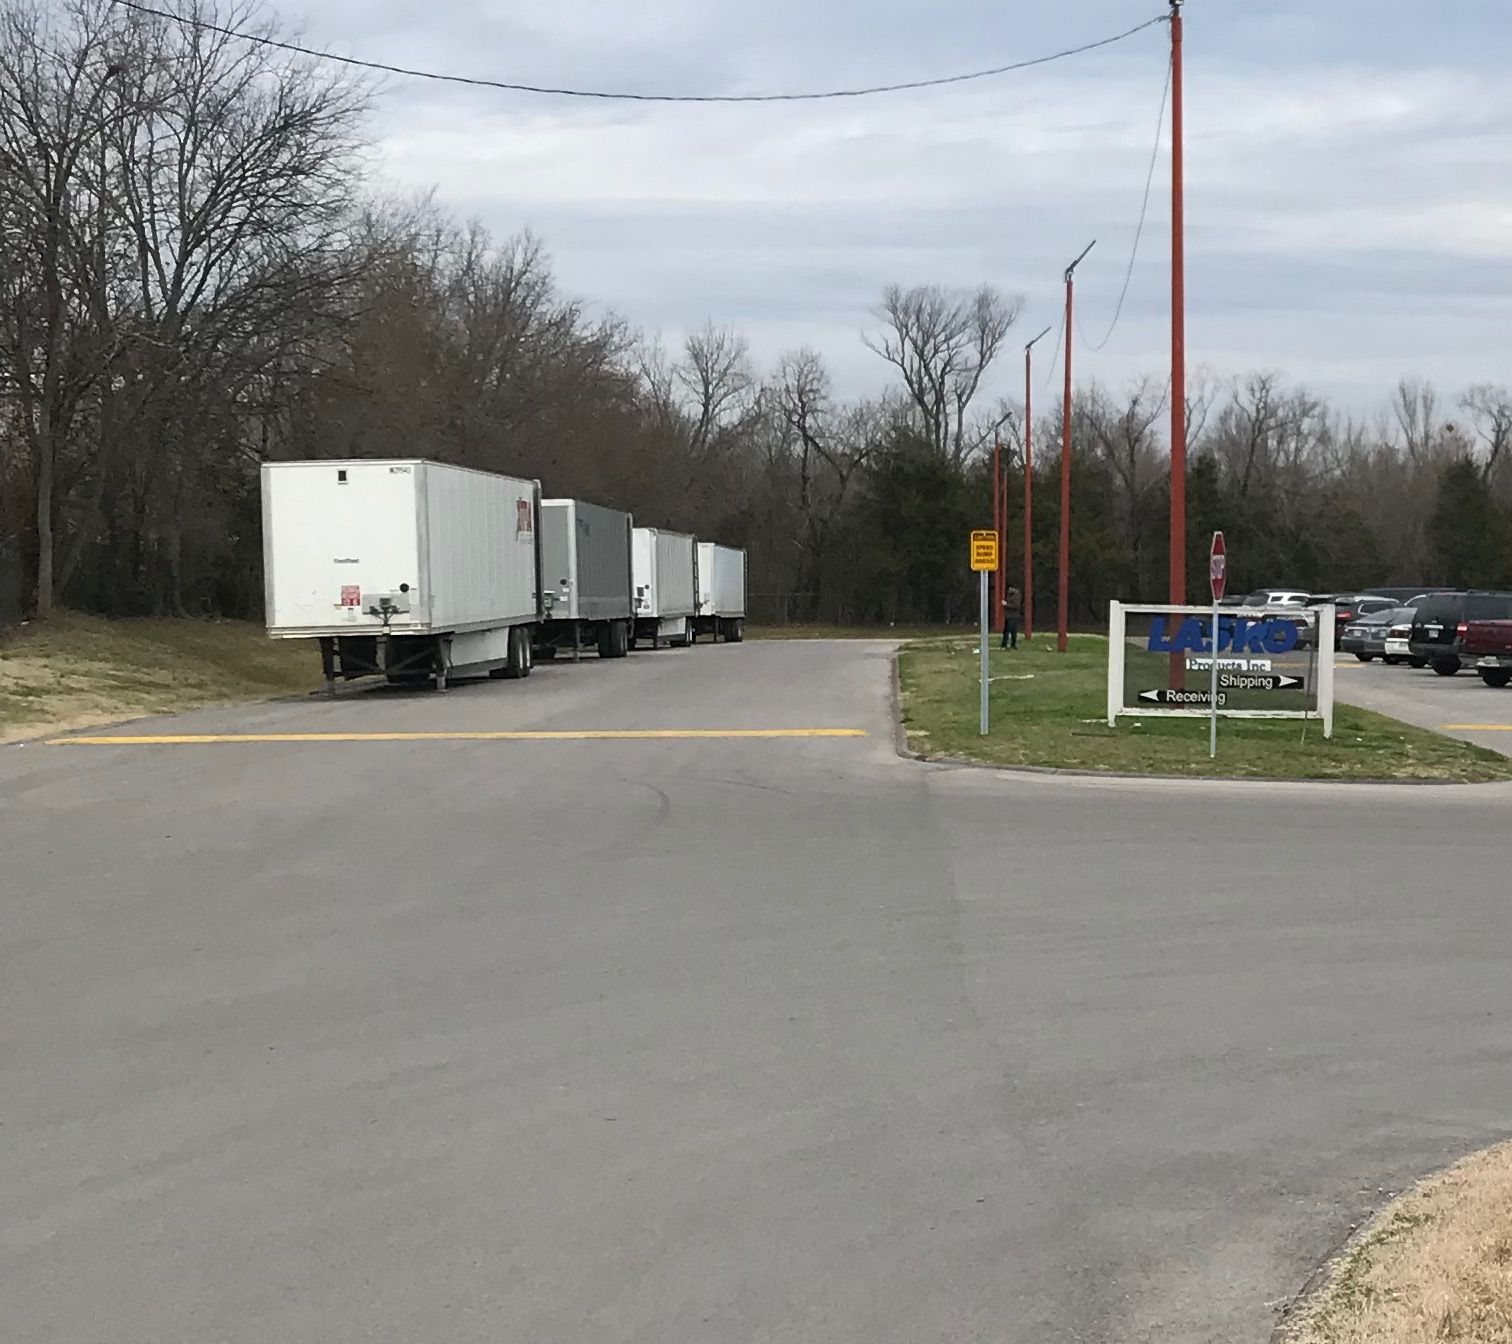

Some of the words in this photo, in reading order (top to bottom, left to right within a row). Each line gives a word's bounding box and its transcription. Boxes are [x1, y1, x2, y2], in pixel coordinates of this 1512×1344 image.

[1148, 616, 1299, 654] LASKO
[1219, 673, 1273, 690] Shipping
[1165, 689, 1226, 705] Receivig
